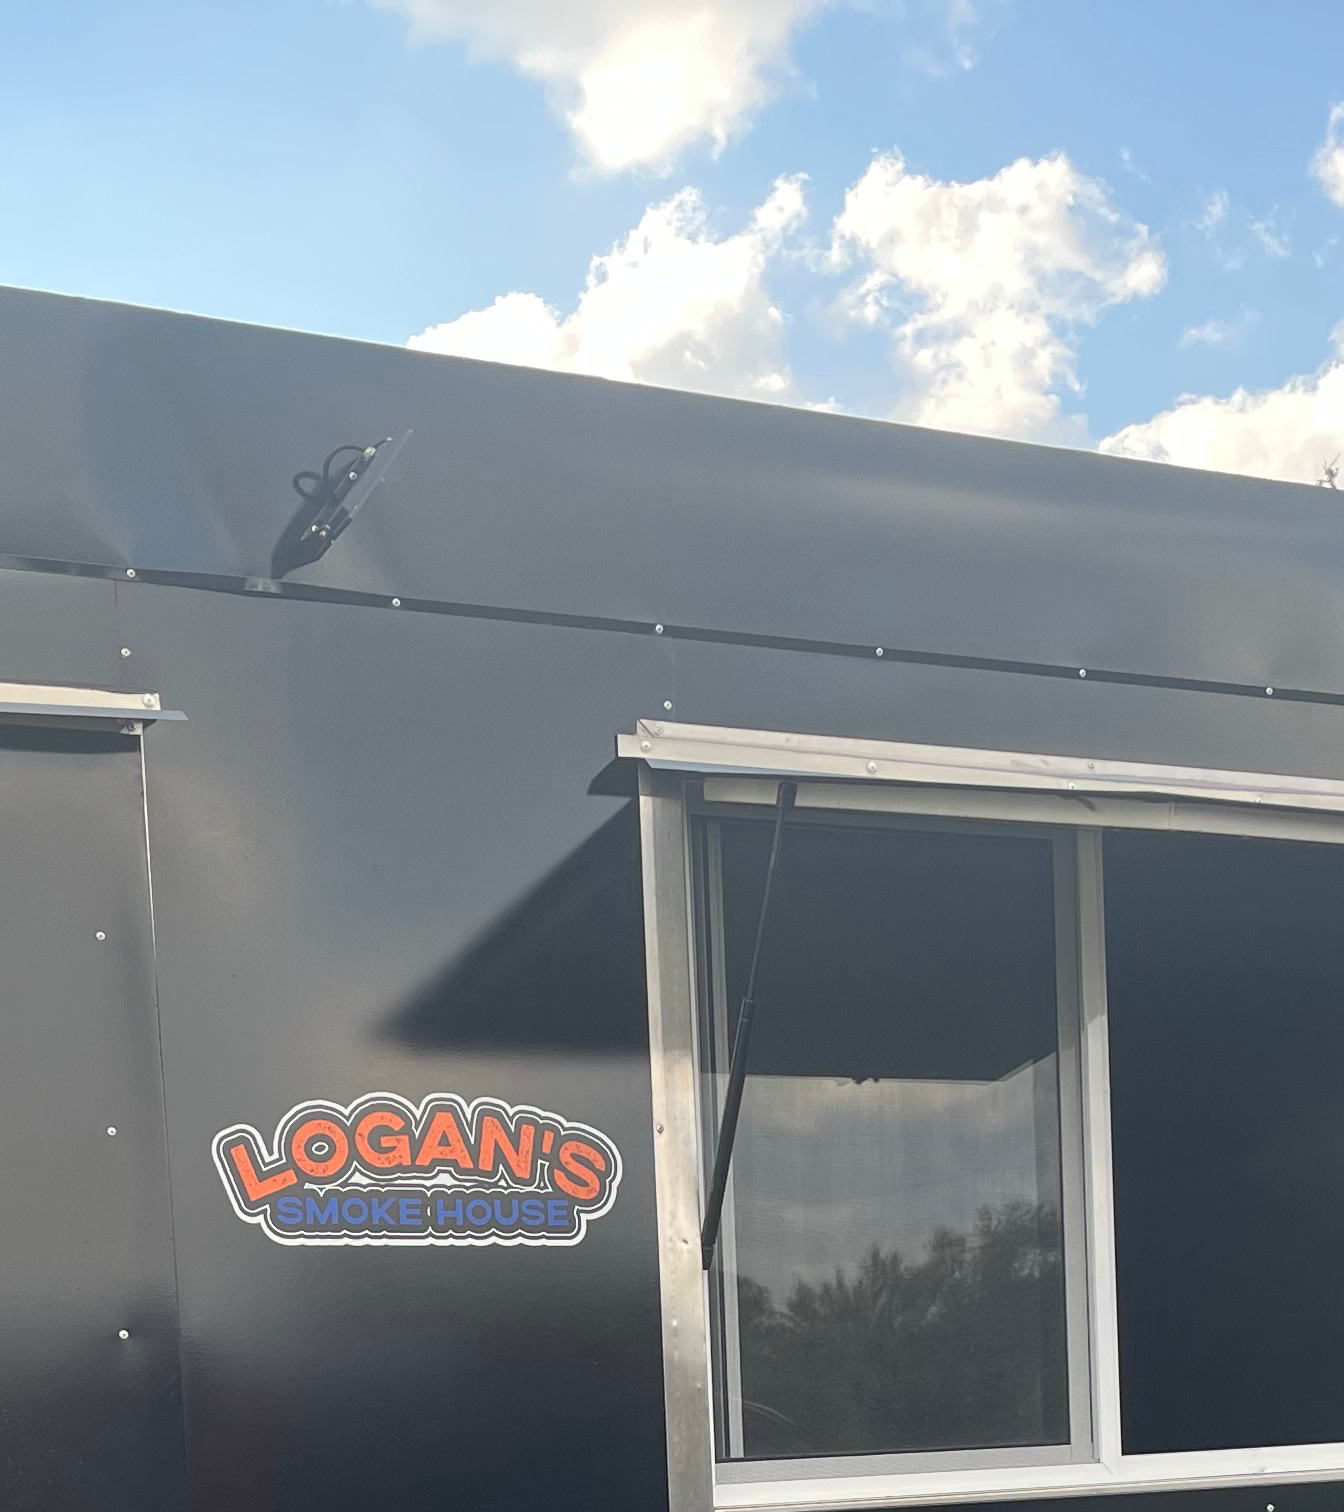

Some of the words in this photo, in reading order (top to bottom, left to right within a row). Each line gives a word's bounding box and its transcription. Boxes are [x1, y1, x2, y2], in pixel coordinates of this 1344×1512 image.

[229, 1111, 605, 1202] LOGAN'S
[275, 1196, 424, 1226] SMOKE
[436, 1198, 570, 1227] HOUSE
